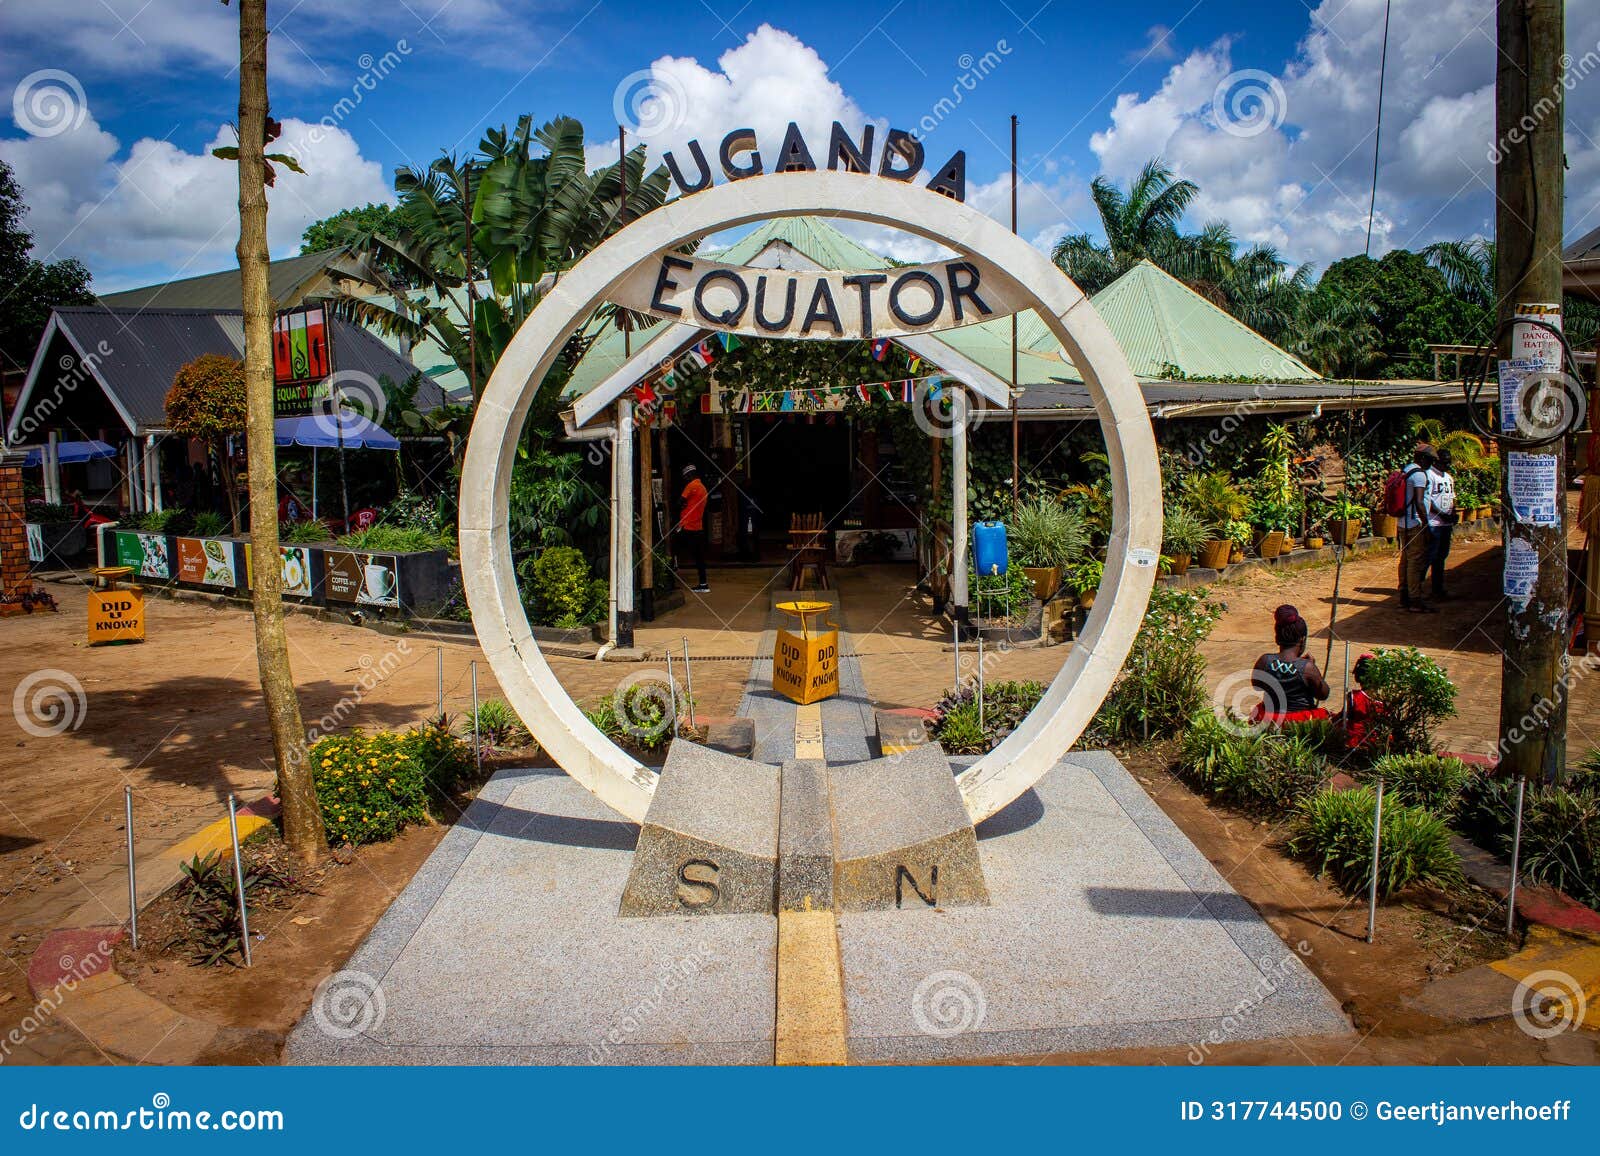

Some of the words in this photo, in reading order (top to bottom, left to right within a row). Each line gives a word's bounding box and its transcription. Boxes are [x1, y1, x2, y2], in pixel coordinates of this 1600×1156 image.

[662, 120, 966, 202] UGANDA
[650, 255, 992, 338] EQUATOR
[102, 601, 132, 612] DID
[109, 611, 122, 619] U
[96, 620, 138, 630] KNOW?
[781, 642, 800, 661] DID
[818, 645, 835, 662] DID
[784, 658, 792, 669] U
[822, 661, 830, 671] U
[776, 666, 802, 688] KNOW?
[678, 857, 720, 908] S
[895, 864, 938, 908] N
